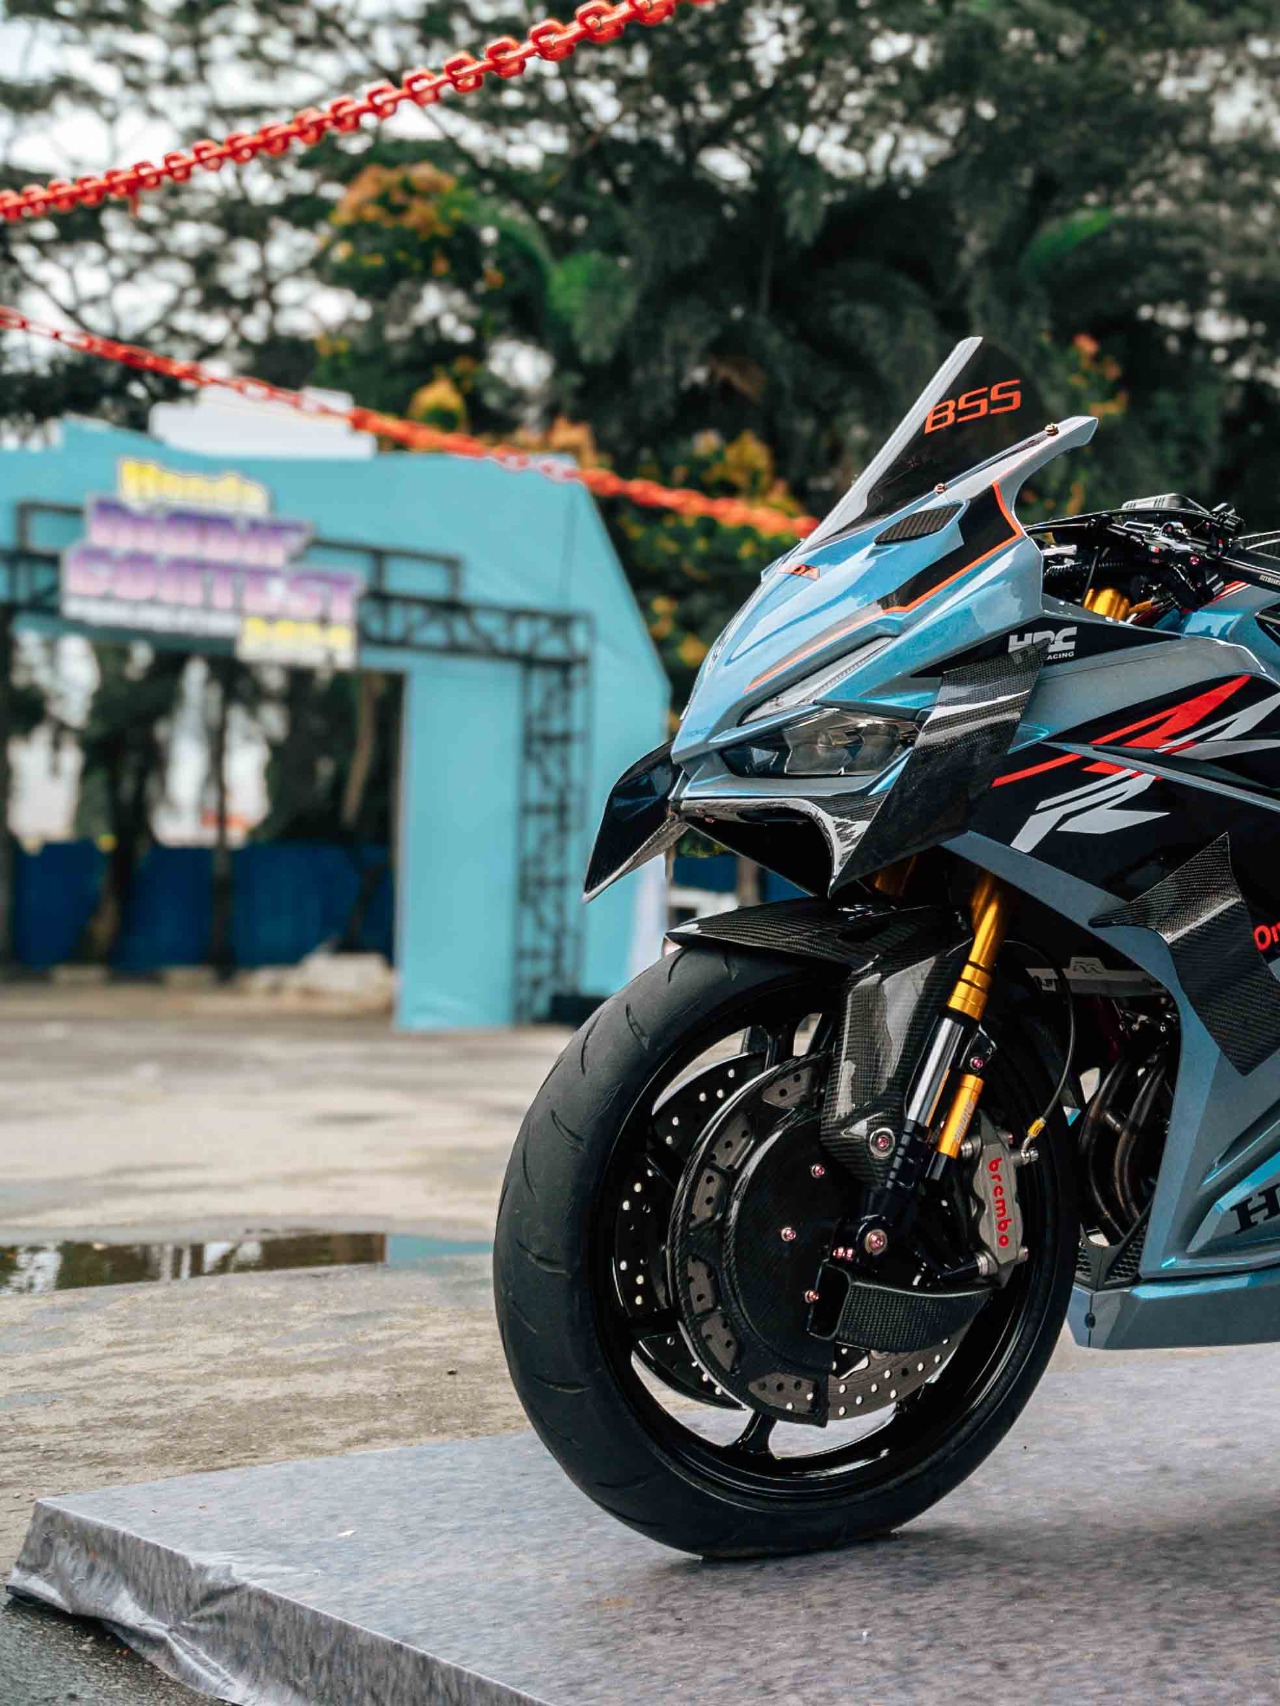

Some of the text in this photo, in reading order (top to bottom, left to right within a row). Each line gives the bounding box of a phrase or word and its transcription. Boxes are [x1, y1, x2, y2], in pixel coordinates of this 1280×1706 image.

[924, 379, 1021, 434] BSS
[1045, 651, 1075, 660] ACING
[988, 1157, 1012, 1247] brembo
